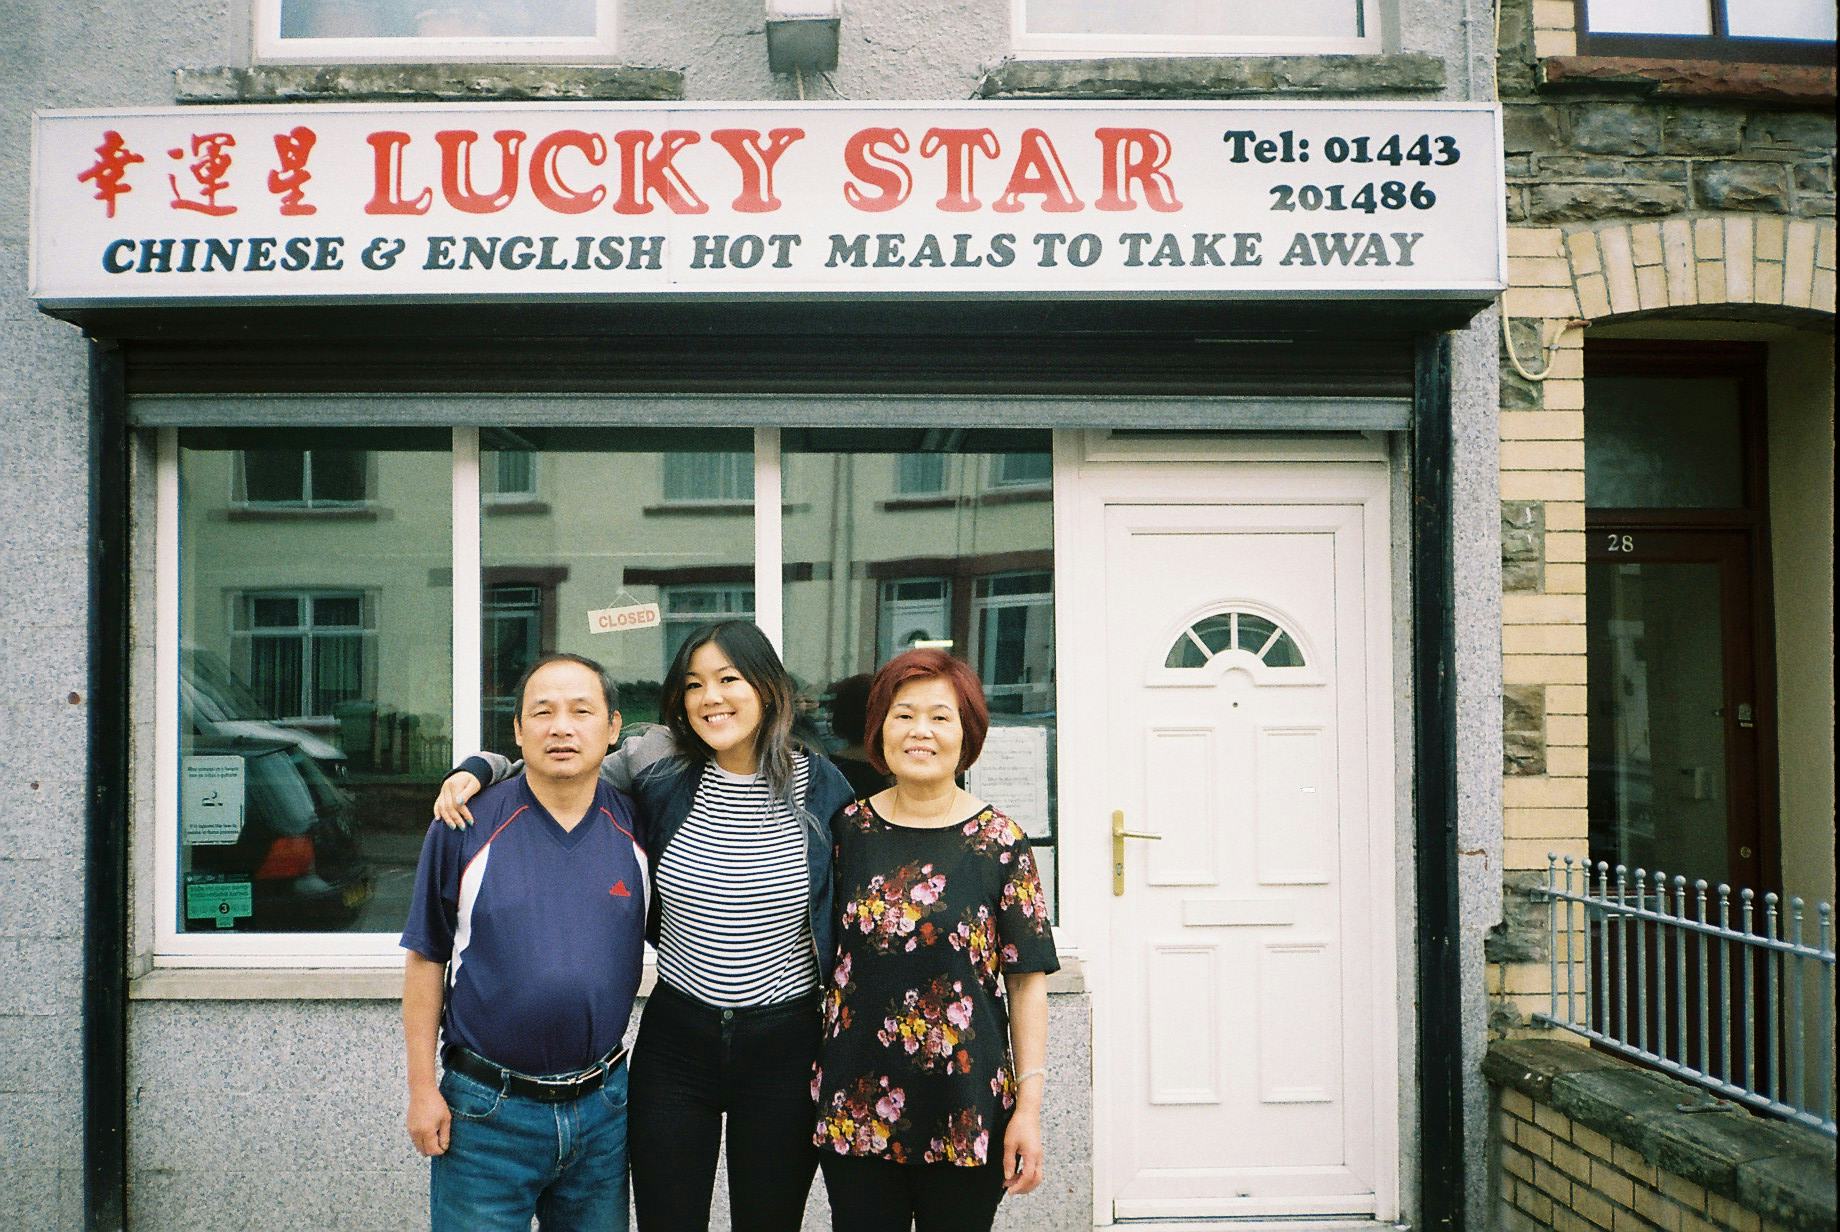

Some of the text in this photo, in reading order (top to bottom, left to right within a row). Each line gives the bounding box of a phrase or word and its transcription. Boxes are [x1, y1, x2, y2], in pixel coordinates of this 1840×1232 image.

[1224, 130, 1460, 166] Tel: 01443
[78, 125, 318, 218] 幸運星
[365, 127, 1182, 215] LUCKY STAR
[1270, 181, 1437, 214] 201486
[103, 233, 1424, 274] CHINESE & ENGLISH HOT MEALS TO TAKE AWAY
[1607, 534, 1634, 552] 28
[598, 610, 656, 628] CLOSED
